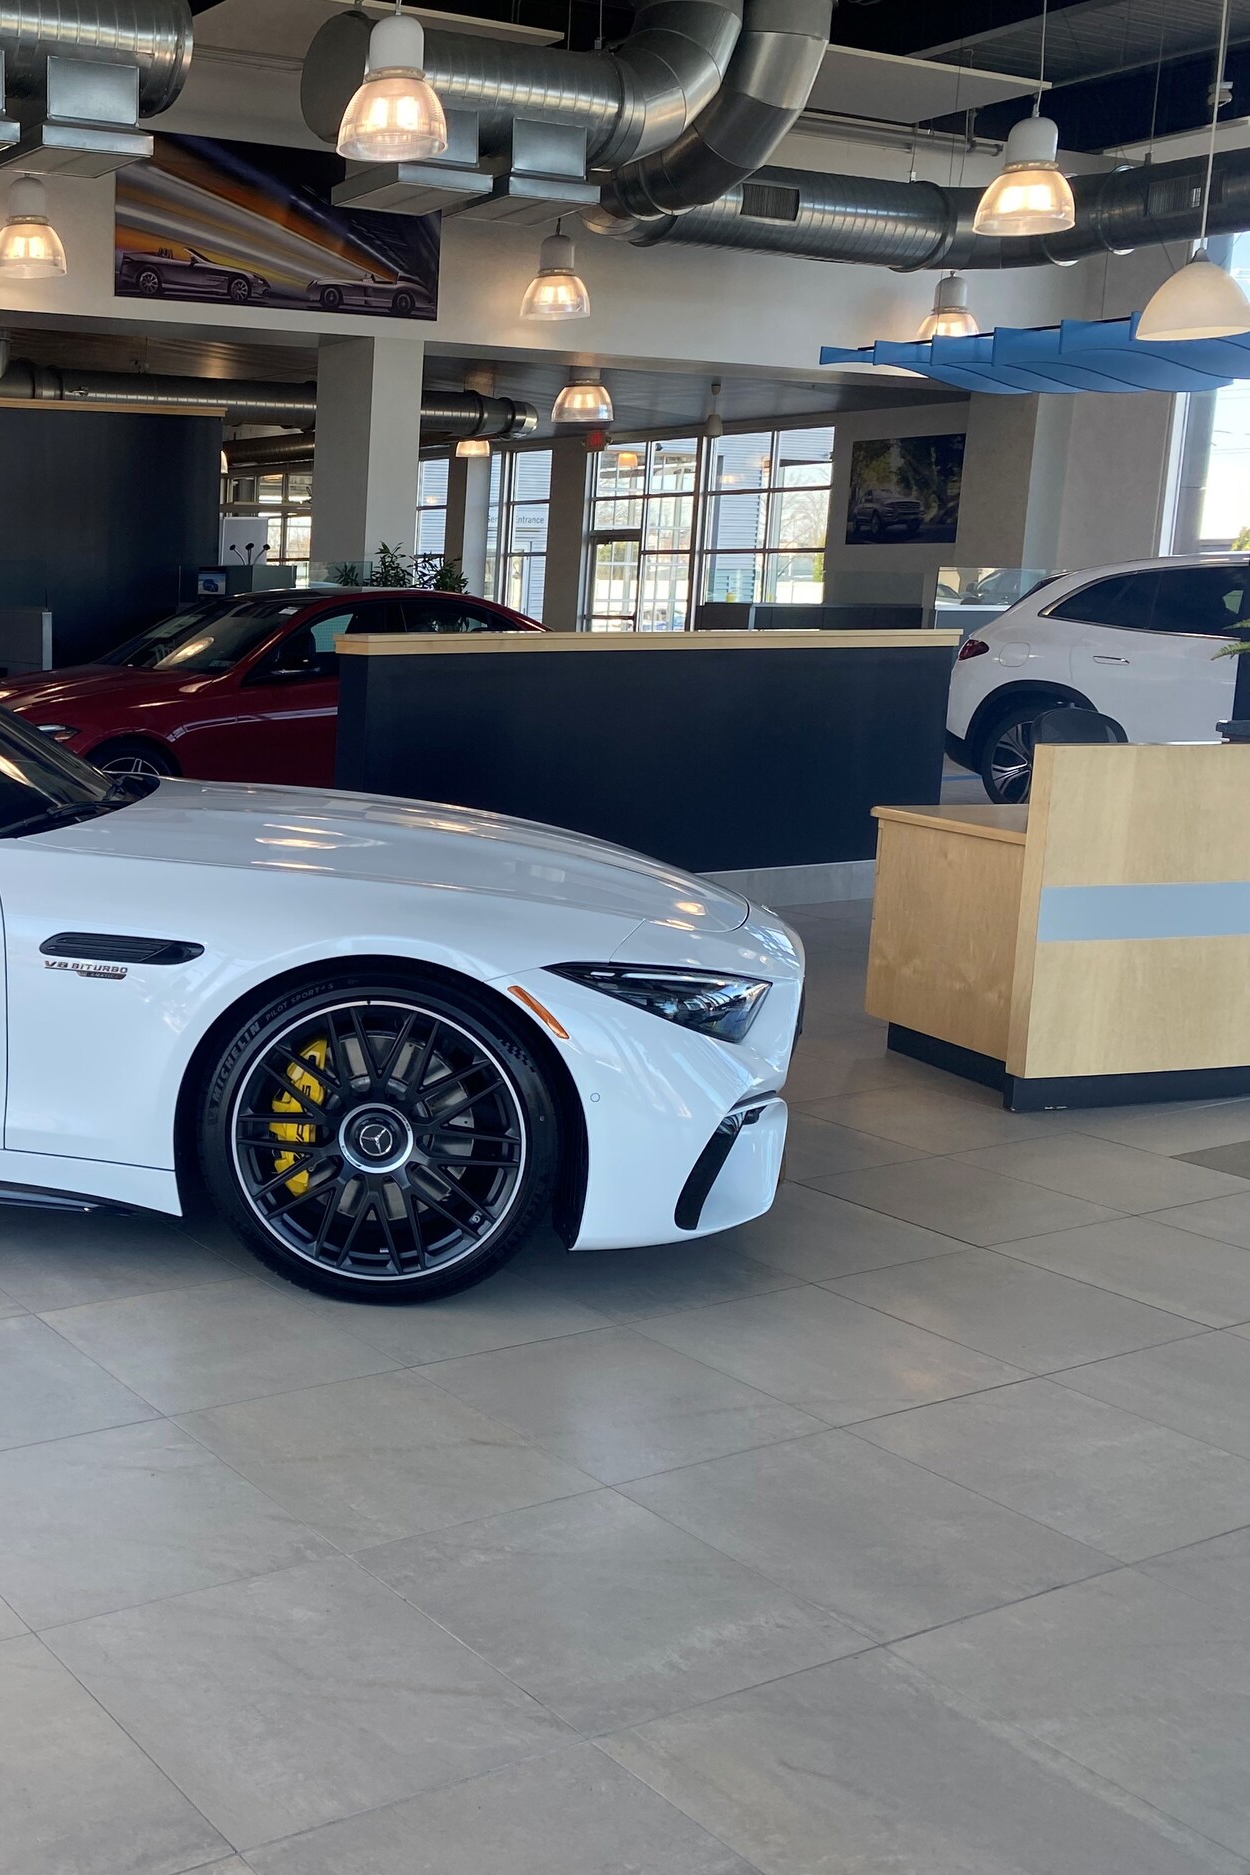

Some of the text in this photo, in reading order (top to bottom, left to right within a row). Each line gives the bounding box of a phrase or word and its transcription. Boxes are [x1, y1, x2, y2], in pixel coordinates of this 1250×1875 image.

[44, 960, 128, 974] V8 BITURBO
[212, 1022, 260, 1101] MICHELIN
[266, 1003, 288, 1021] PILOT
[291, 988, 319, 1004] SPORT
